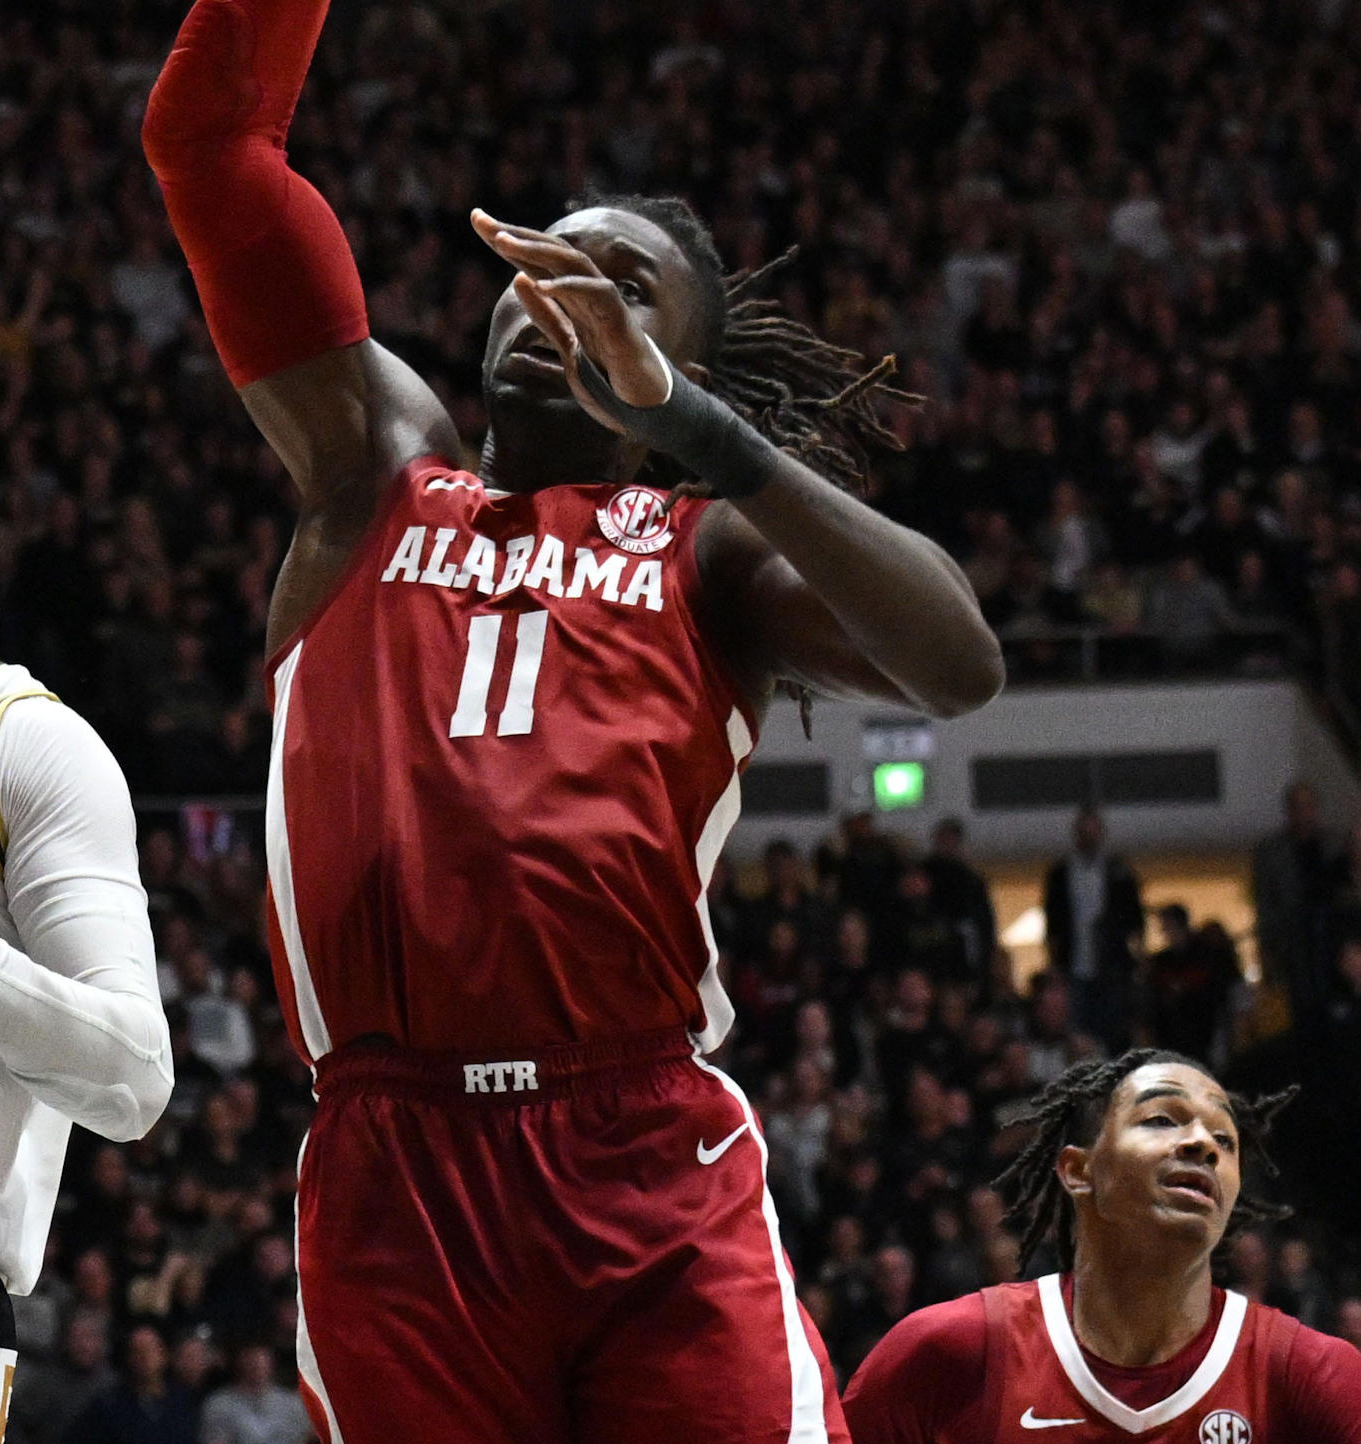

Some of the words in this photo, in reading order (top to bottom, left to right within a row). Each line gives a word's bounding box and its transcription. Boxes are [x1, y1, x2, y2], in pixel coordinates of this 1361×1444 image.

[599, 519, 660, 552] GRADUATE
[612, 490, 665, 538] SEC
[381, 526, 664, 612] ALABAMA
[449, 610, 549, 738] 11
[463, 1060, 538, 1094] RTR
